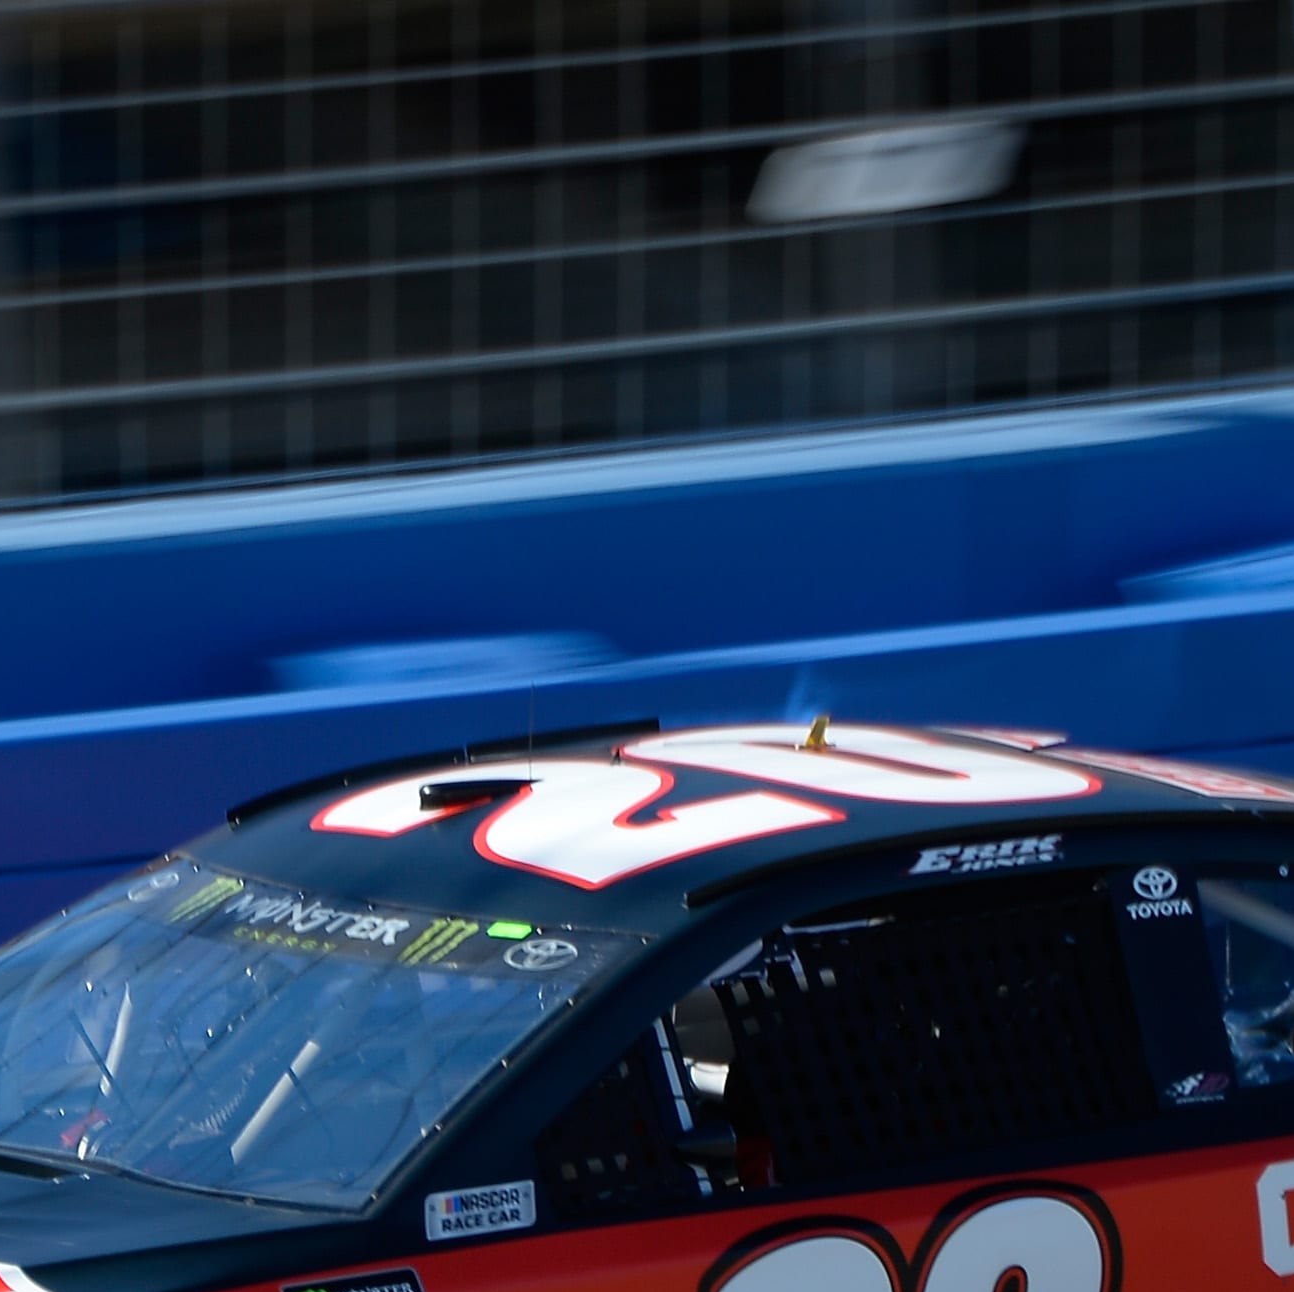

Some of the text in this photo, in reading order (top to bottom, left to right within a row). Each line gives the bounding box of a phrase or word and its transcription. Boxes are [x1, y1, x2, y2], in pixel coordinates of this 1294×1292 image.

[312, 723, 1100, 889] 20
[225, 893, 410, 946] MONSTER
[1126, 900, 1193, 920] TOYOTA
[462, 1188, 521, 1212] NASCAR
[442, 1209, 521, 1232] RACE CAR
